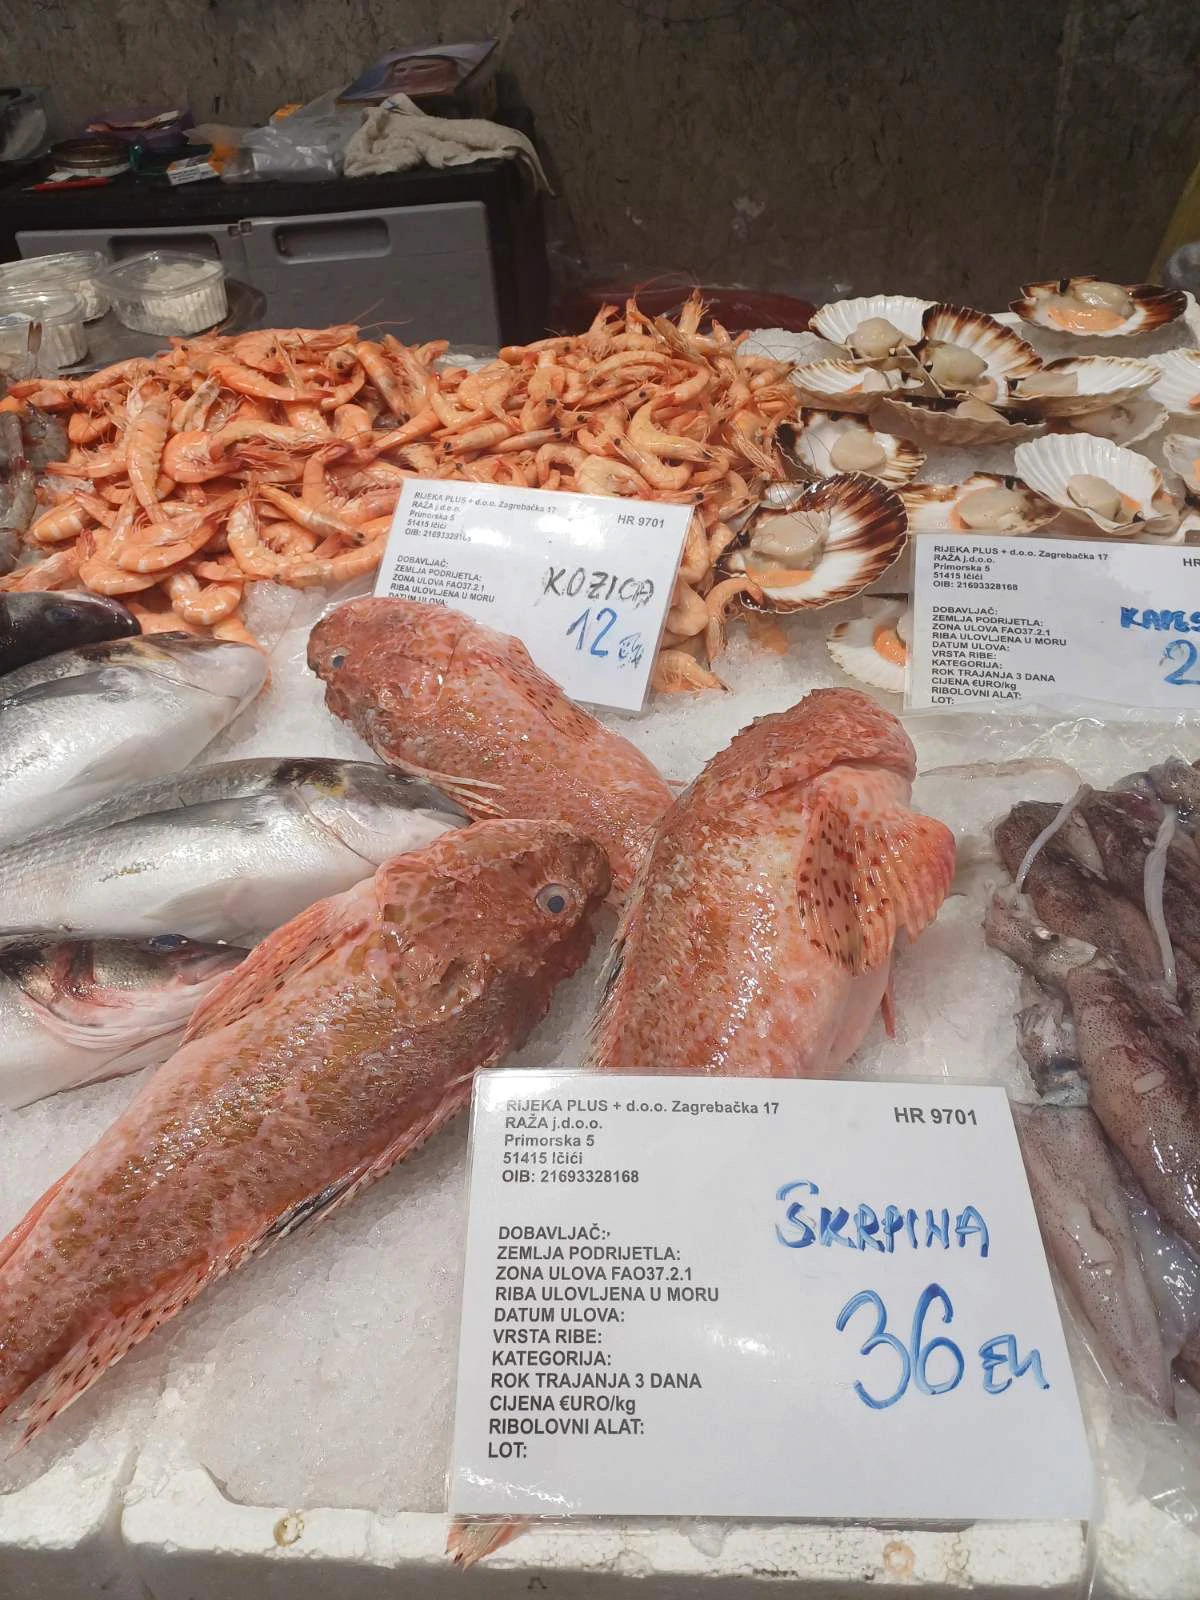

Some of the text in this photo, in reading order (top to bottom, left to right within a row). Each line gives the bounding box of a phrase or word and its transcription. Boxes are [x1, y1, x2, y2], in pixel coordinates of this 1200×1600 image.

[617, 514, 665, 528] HR 9701
[934, 545, 970, 554] RIJEKA
[972, 546, 999, 555] PLUS
[1010, 549, 1036, 558] d.o.o.
[1039, 550, 1095, 561] Zagrebačka
[1098, 553, 1108, 561] 17
[934, 553, 994, 565] RAŽA j.d.o.o.
[394, 564, 482, 582] ZEMLJA PODRIJETLA:
[934, 563, 991, 572] Primorska 5
[392, 573, 485, 592] ZONA ULOVA FAO37.2.1
[933, 571, 983, 581] 51415 Ičići
[933, 580, 1018, 591] OIB: 21693328168
[390, 583, 495, 604] RIBA ULOVLJENA U MORU
[932, 606, 998, 615] DOBAVLJAČ:
[932, 614, 1044, 627] ZEMLJA PODRIJETLA:
[567, 607, 618, 657] 12
[932, 623, 1051, 636] ZONA ULOVA FAO37.2.1
[932, 632, 1067, 647] RIBA ULOVLJENA U MORU
[932, 641, 1010, 652] DATUM ULOVA:
[931, 650, 997, 660] VRSTA RIBE:
[931, 659, 1003, 670] KATEGORIJA:
[931, 668, 1056, 682] ROK TRAJANJA 3 DANA
[931, 677, 970, 687] CIJENA
[931, 686, 1022, 700] RIBOLOVNI ALAT:
[931, 696, 955, 705] LOT:
[506, 1099, 779, 1116] RIJEKA PLUS + d.o.o. Zagrebačka 17
[505, 1112, 603, 1131] RAŽA j.d.o.o.
[894, 1107, 978, 1126] HR 9701
[504, 1133, 595, 1147] Primorska 5
[503, 1150, 583, 1165] 51415 Ičići
[502, 1169, 640, 1183] OIB: 21693328168
[496, 1246, 681, 1261] ZEMLJA PODRIJETLA:
[496, 1266, 692, 1281] ZONA ULOVA FAO37.2.1
[495, 1286, 719, 1302] RIBA ULOVLJENA U MORU
[494, 1307, 625, 1323] DATUM ULOVA:
[493, 1329, 602, 1344] VRSTA RIBE:
[836, 1282, 965, 1409] 36
[492, 1350, 612, 1366] KATEGORIJA:
[491, 1373, 703, 1389] ROK TRAJANJA 3 DANA
[490, 1395, 636, 1415] CIJENA €URO/kg
[489, 1418, 645, 1435] RIBOLOVNI ALAT:
[488, 1441, 528, 1458] LOT:
